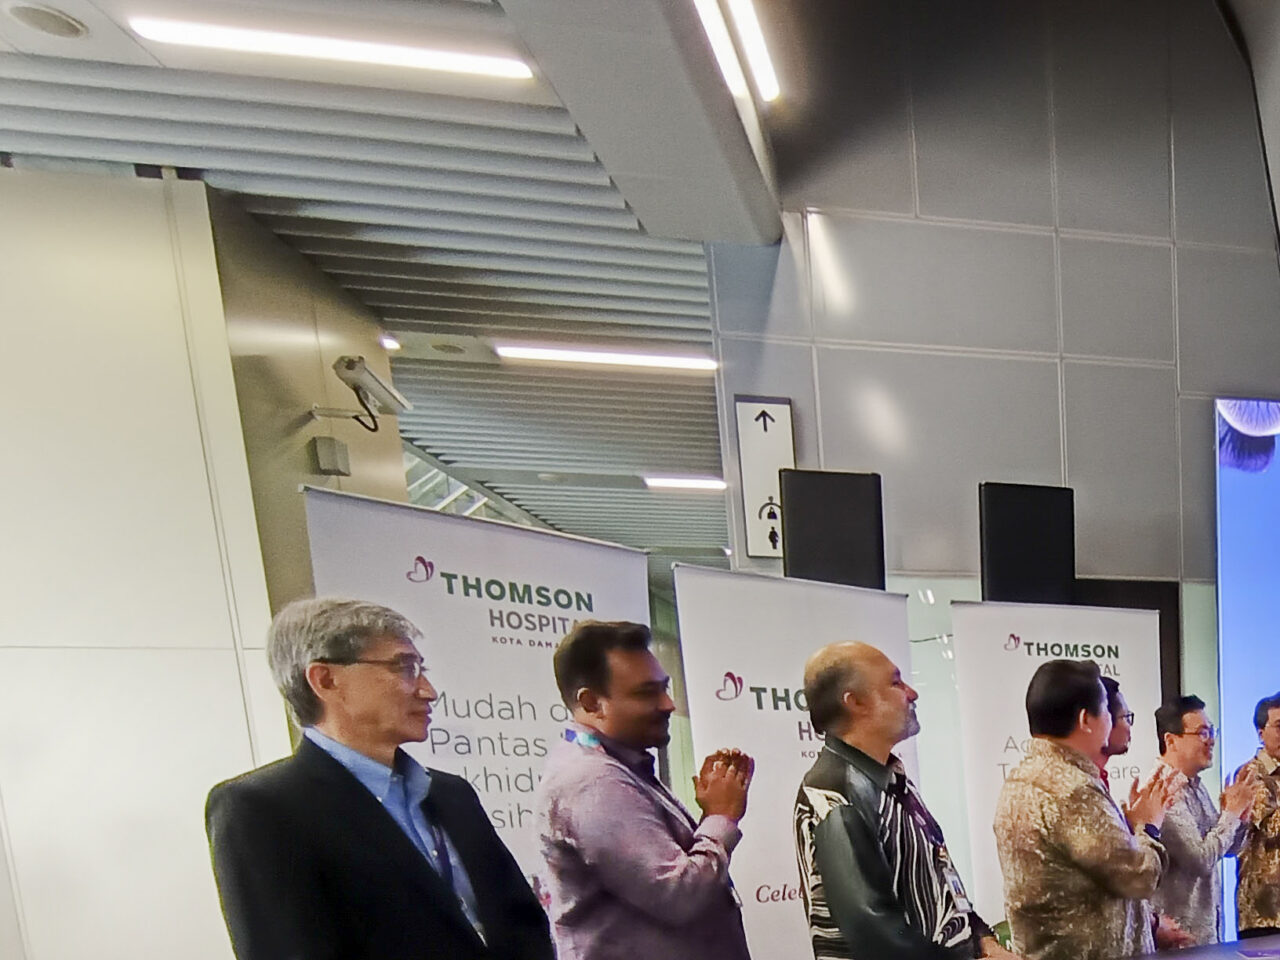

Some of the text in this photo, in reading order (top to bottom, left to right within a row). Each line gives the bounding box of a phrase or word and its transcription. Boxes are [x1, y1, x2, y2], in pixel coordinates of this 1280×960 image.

[440, 571, 594, 613] THOMSON
[488, 608, 578, 636] HOSPIT
[491, 636, 523, 646] KOTA
[1023, 641, 1120, 659] THOMSON
[749, 686, 811, 712] THO
[429, 727, 549, 758] Pantas
[755, 883, 804, 904] Cele
